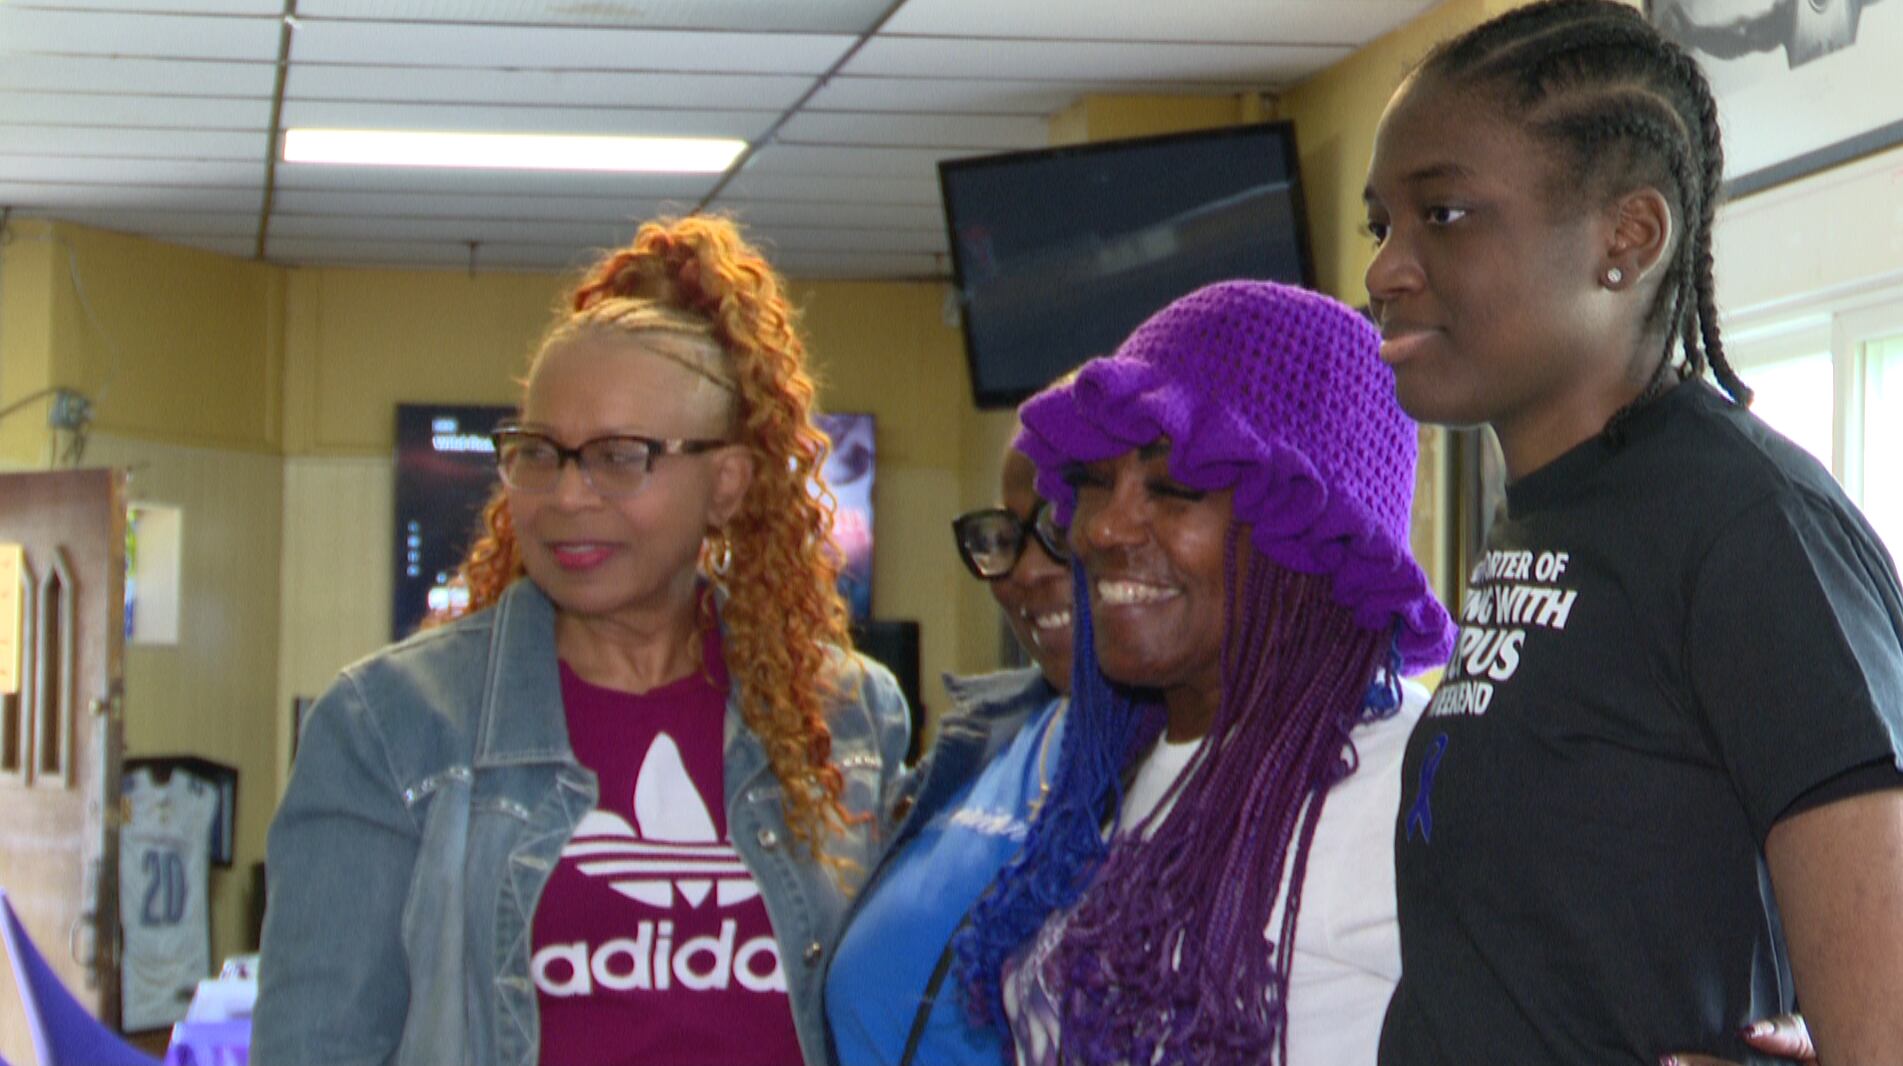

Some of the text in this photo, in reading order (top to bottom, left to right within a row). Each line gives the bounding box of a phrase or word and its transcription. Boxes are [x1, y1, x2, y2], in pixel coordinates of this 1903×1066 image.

[1535, 550, 1569, 582] OF
[1495, 584, 1577, 630] WITH
[140, 849, 188, 927] 20
[530, 918, 788, 997] adida
